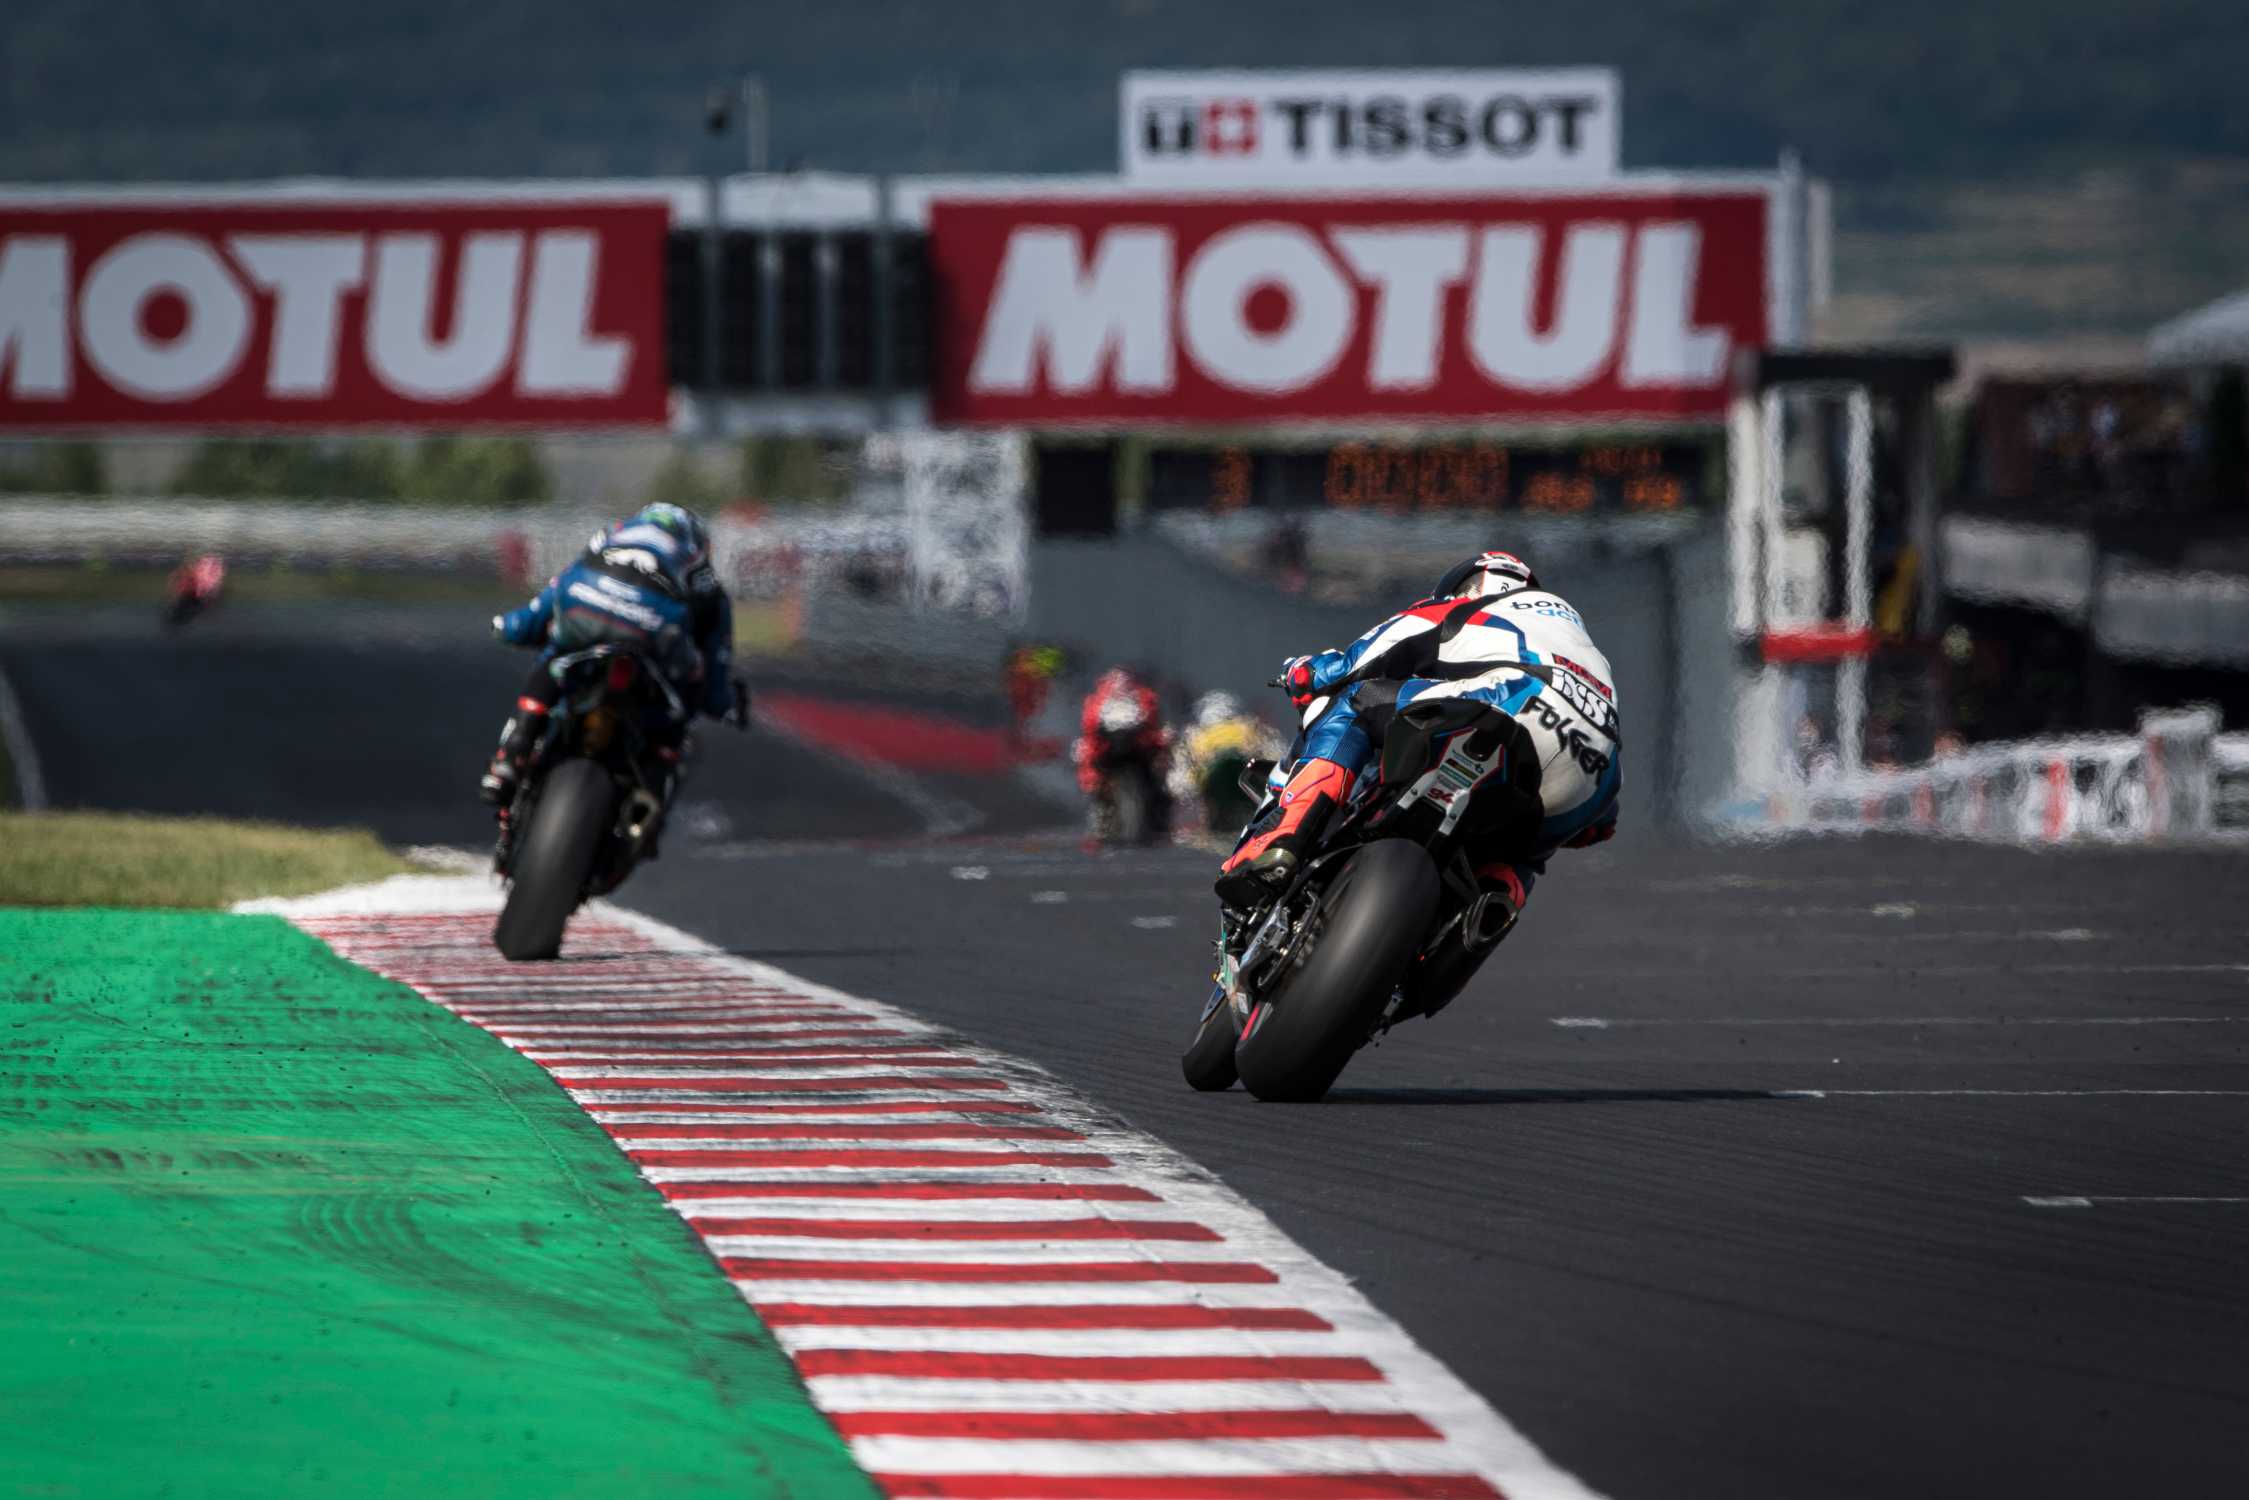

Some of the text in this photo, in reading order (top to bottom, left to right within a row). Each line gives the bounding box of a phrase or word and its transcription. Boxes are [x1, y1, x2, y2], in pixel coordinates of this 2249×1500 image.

[1274, 97, 1598, 158] TISSOT
[970, 220, 1731, 393] MOTUL
[1520, 696, 1610, 787] FOLGER
